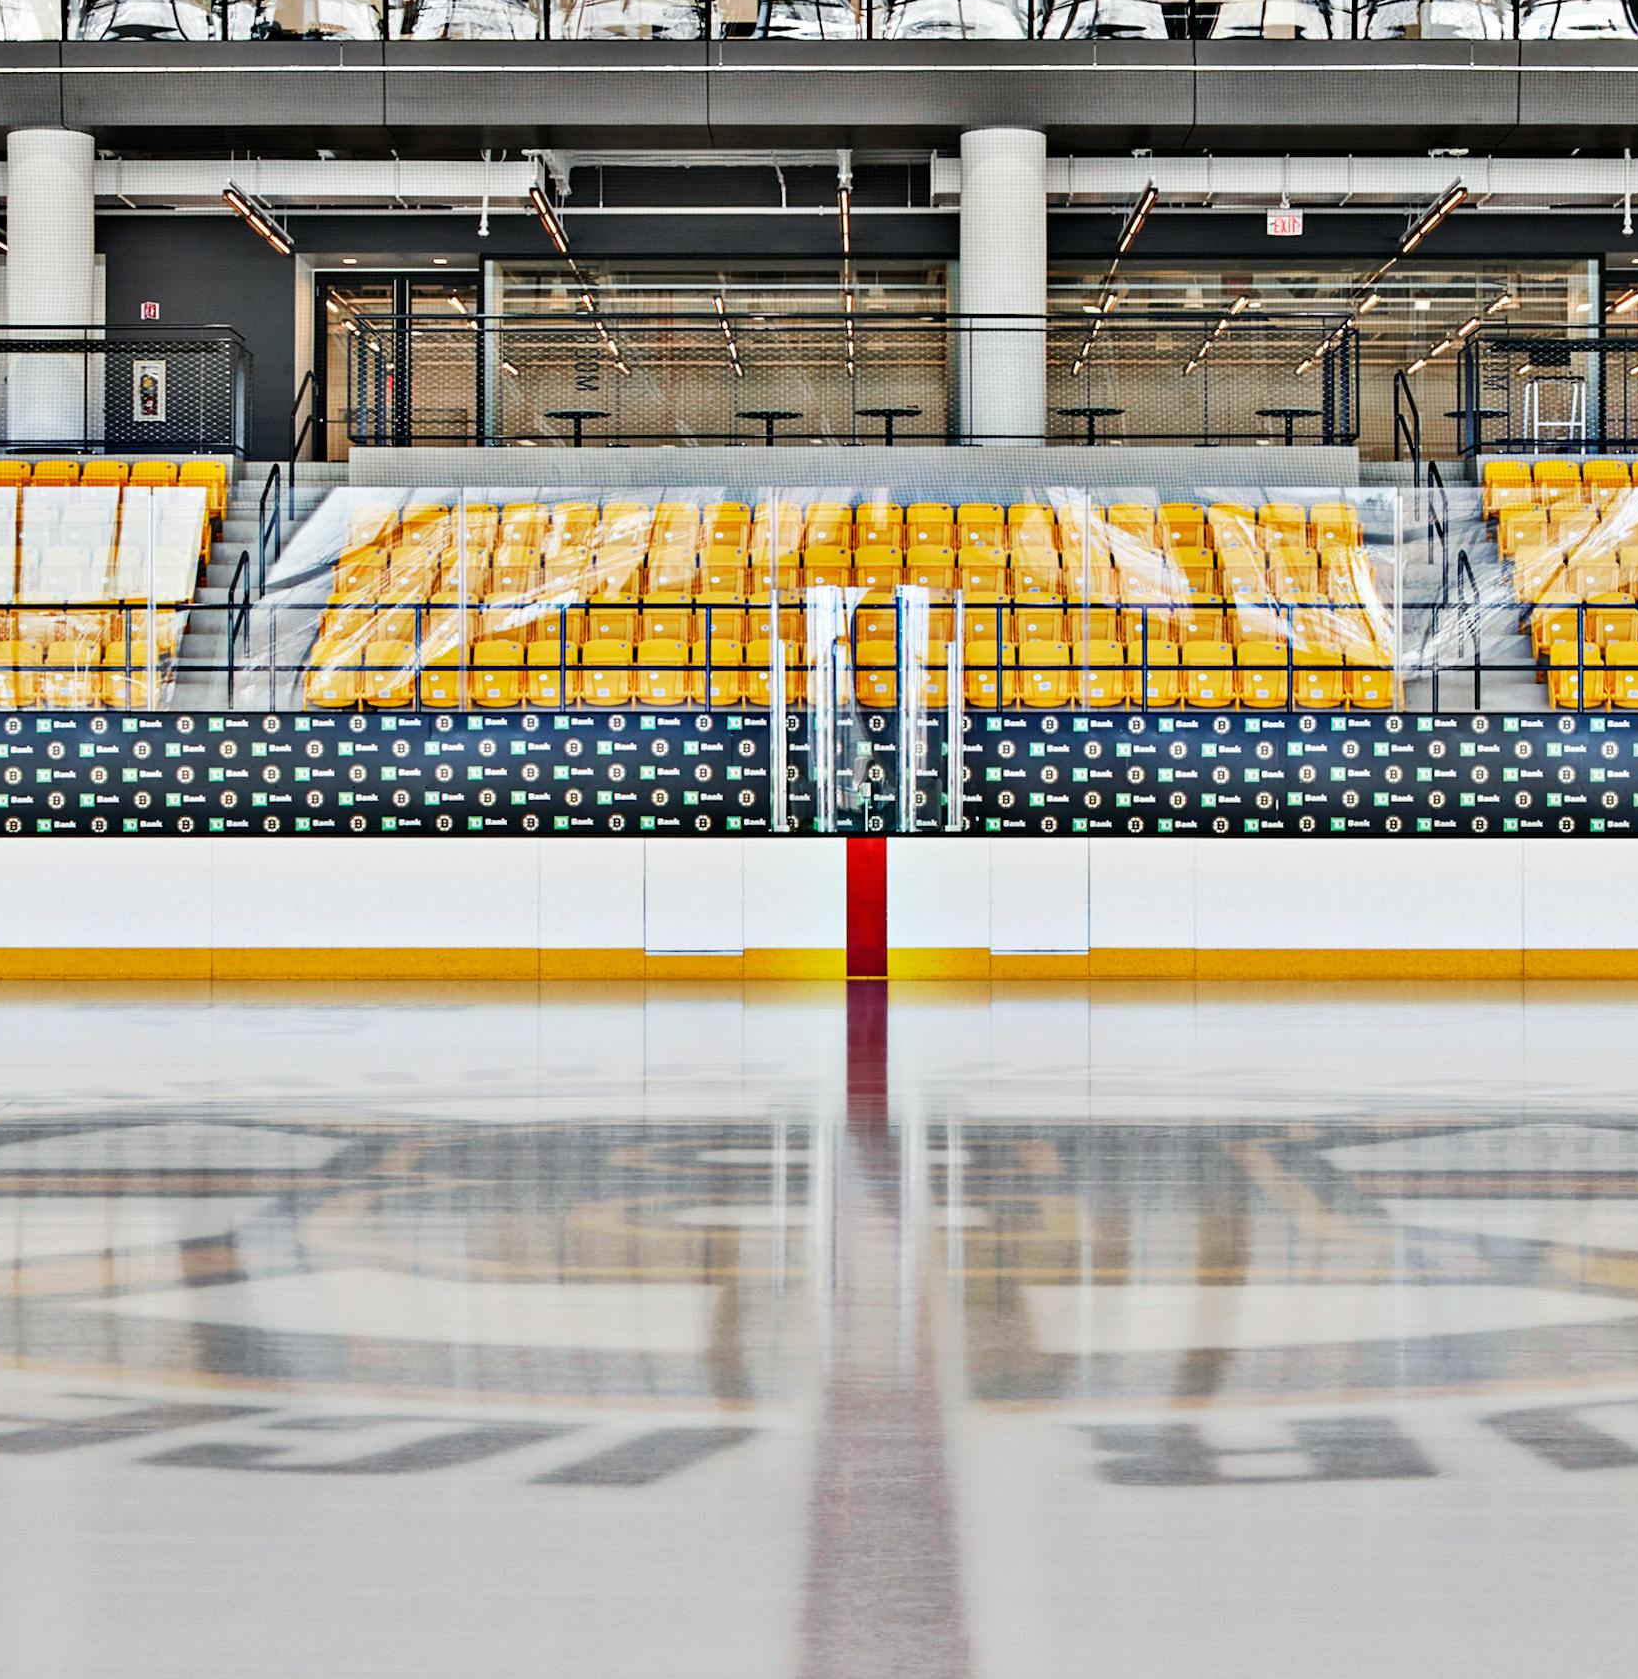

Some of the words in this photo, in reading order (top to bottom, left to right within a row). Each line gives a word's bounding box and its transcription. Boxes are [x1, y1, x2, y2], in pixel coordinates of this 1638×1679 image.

[54, 820, 77, 829] Bank
[140, 819, 163, 828] Bank
[226, 819, 249, 828] Bank
[312, 818, 335, 827] Bank
[399, 818, 422, 827] Bank
[485, 817, 508, 826] Bank
[571, 817, 594, 826] Bank
[657, 817, 680, 826] Bank
[744, 817, 767, 826] Bank
[1003, 819, 1026, 828] Bank
[1089, 819, 1112, 828] Bank
[1175, 819, 1198, 828] Bank
[1261, 820, 1284, 829] Bank
[1348, 819, 1371, 828] Bank
[1434, 819, 1457, 828] Bank
[1520, 819, 1543, 828] Bank
[1607, 819, 1630, 828] Bank
